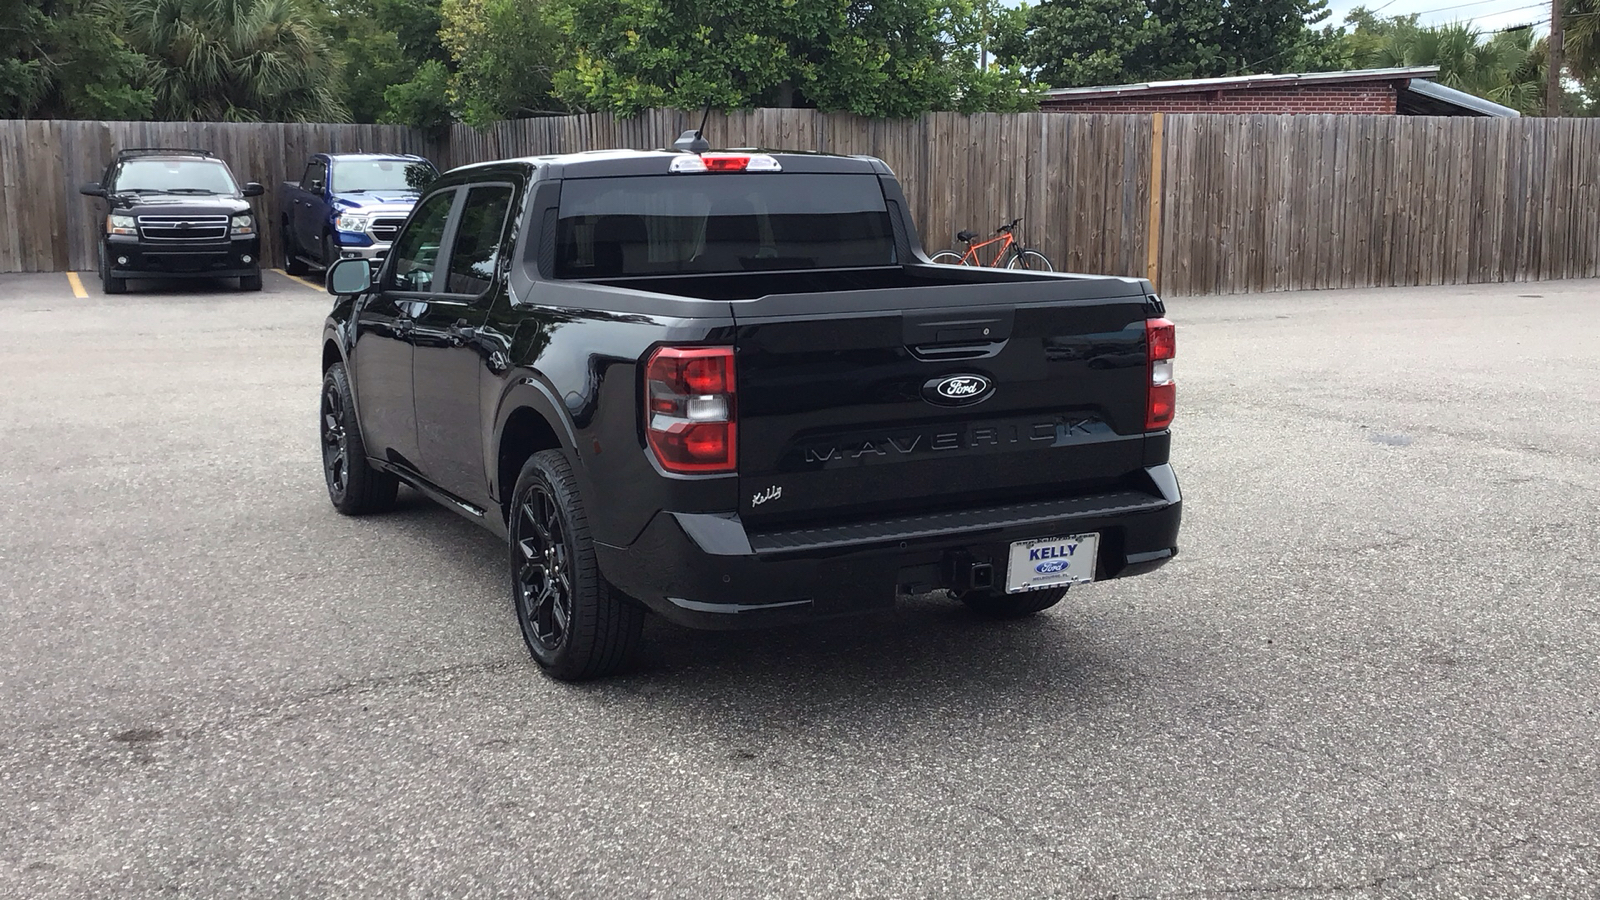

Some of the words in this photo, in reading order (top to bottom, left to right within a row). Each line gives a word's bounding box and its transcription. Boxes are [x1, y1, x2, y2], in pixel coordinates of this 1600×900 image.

[946, 379, 978, 395] Ford
[805, 418, 1092, 462] MAVERICK
[752, 485, 782, 508] Kelly
[1029, 544, 1078, 561] KELLY
[1041, 562, 1064, 573] Ford
